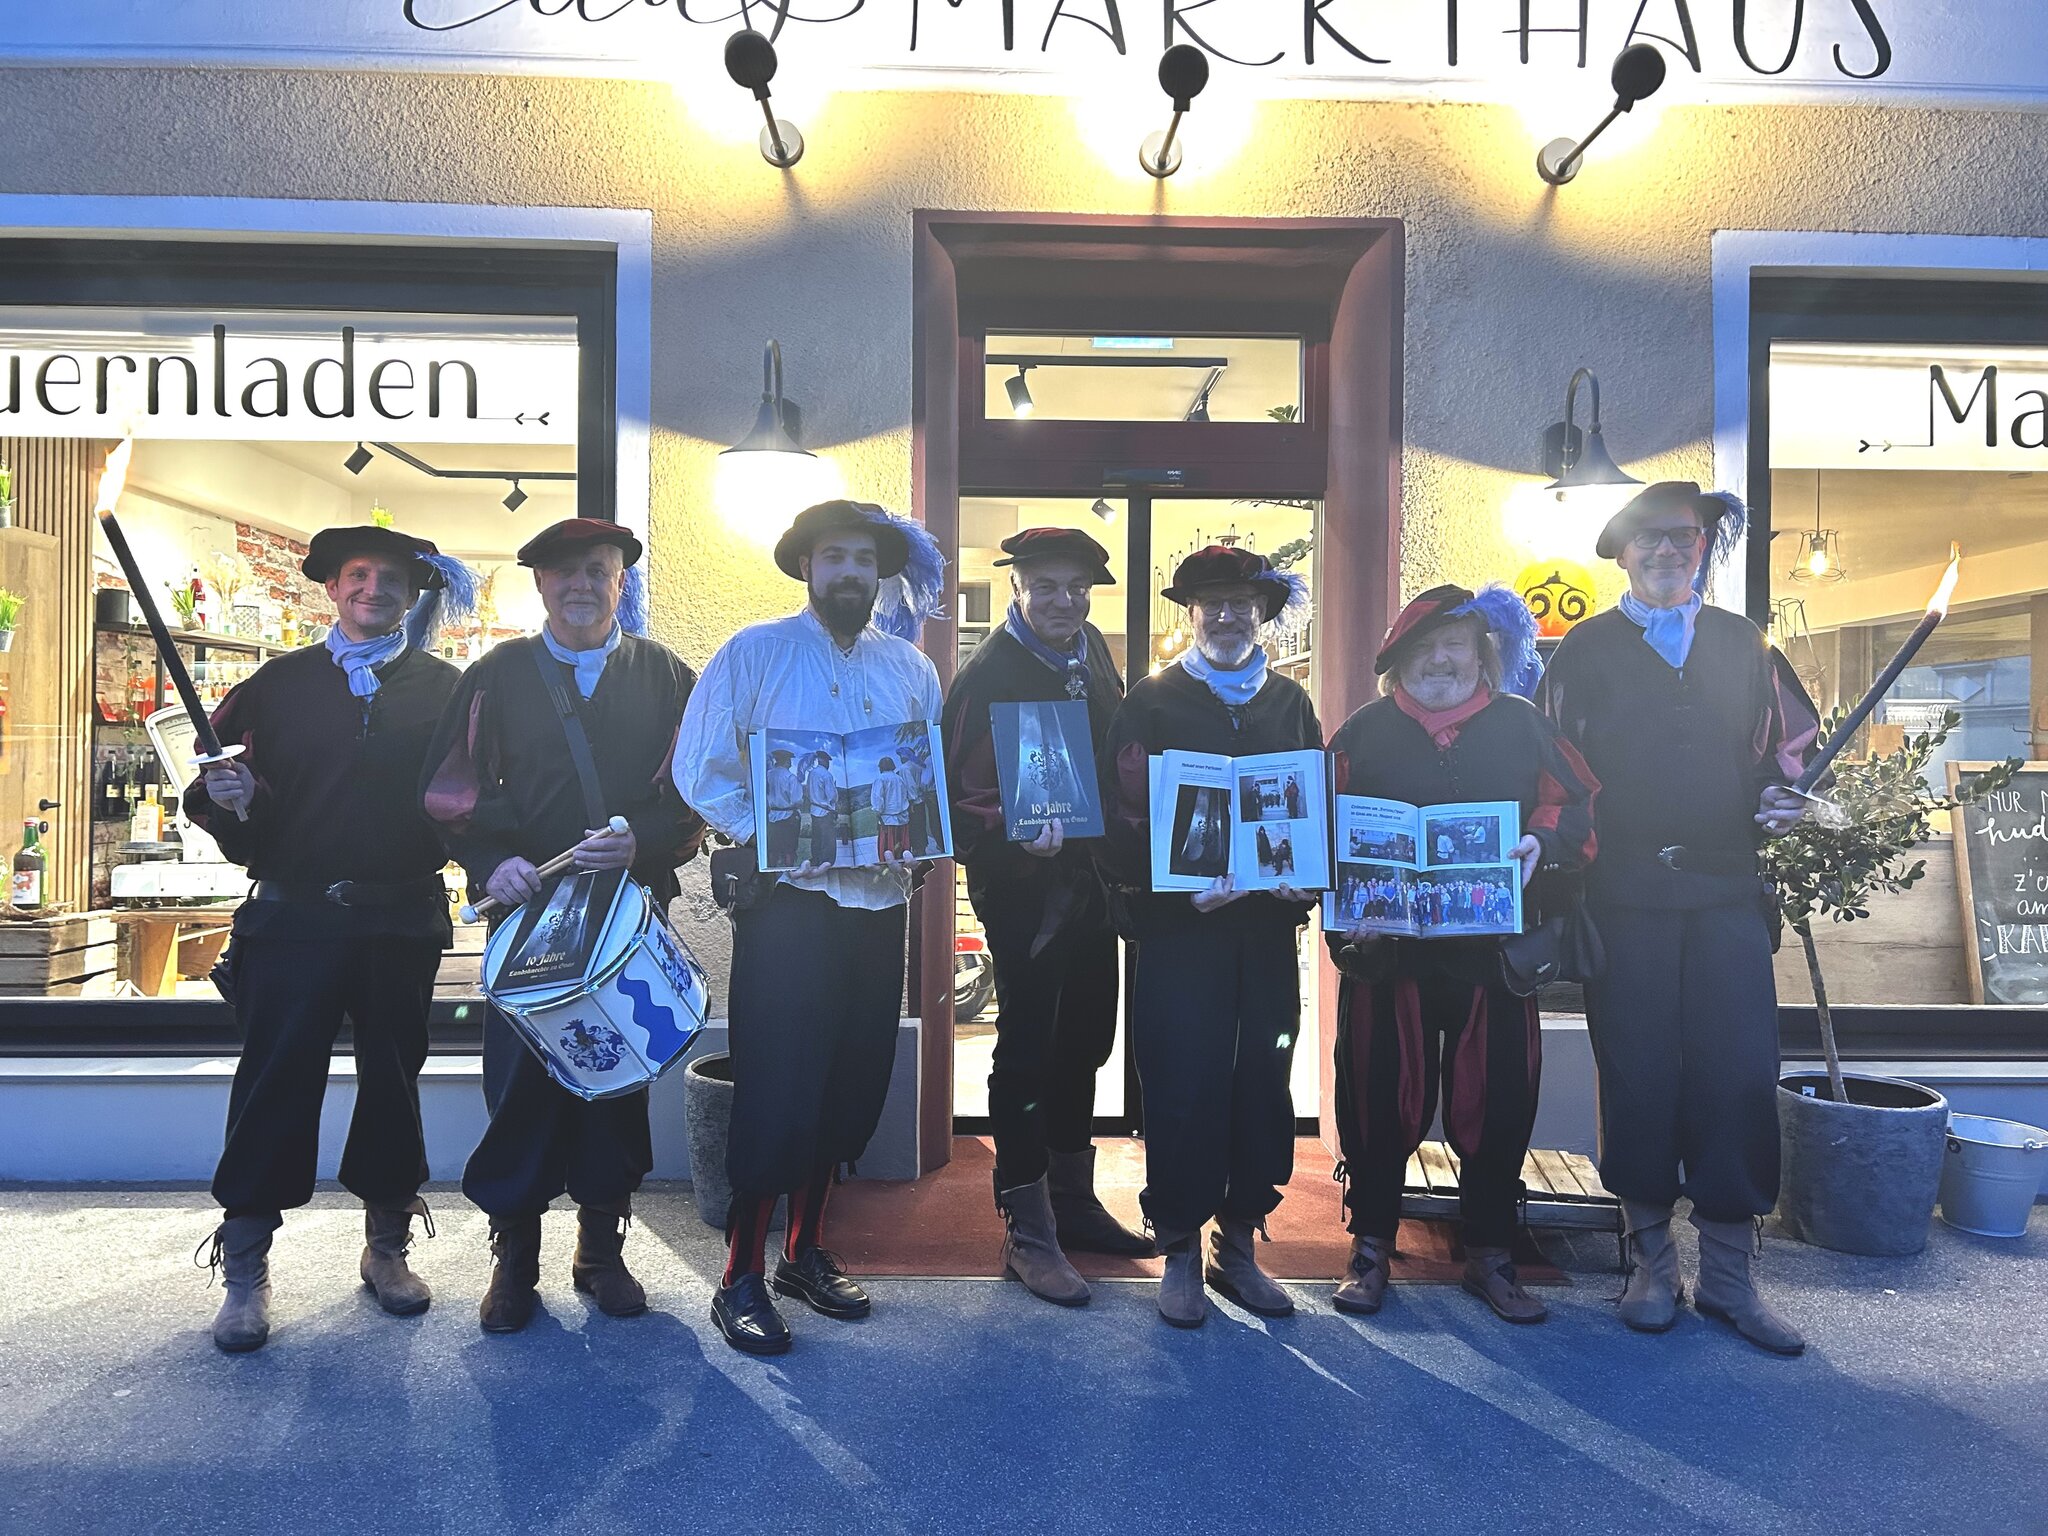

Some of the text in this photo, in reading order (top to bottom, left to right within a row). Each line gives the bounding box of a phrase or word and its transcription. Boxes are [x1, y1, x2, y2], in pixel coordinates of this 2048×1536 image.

[1929, 364, 2048, 449] Ma
[1042, 801, 1072, 816] Jahre
[1987, 790, 2028, 813] NUR
[536, 951, 566, 967] Jahre
